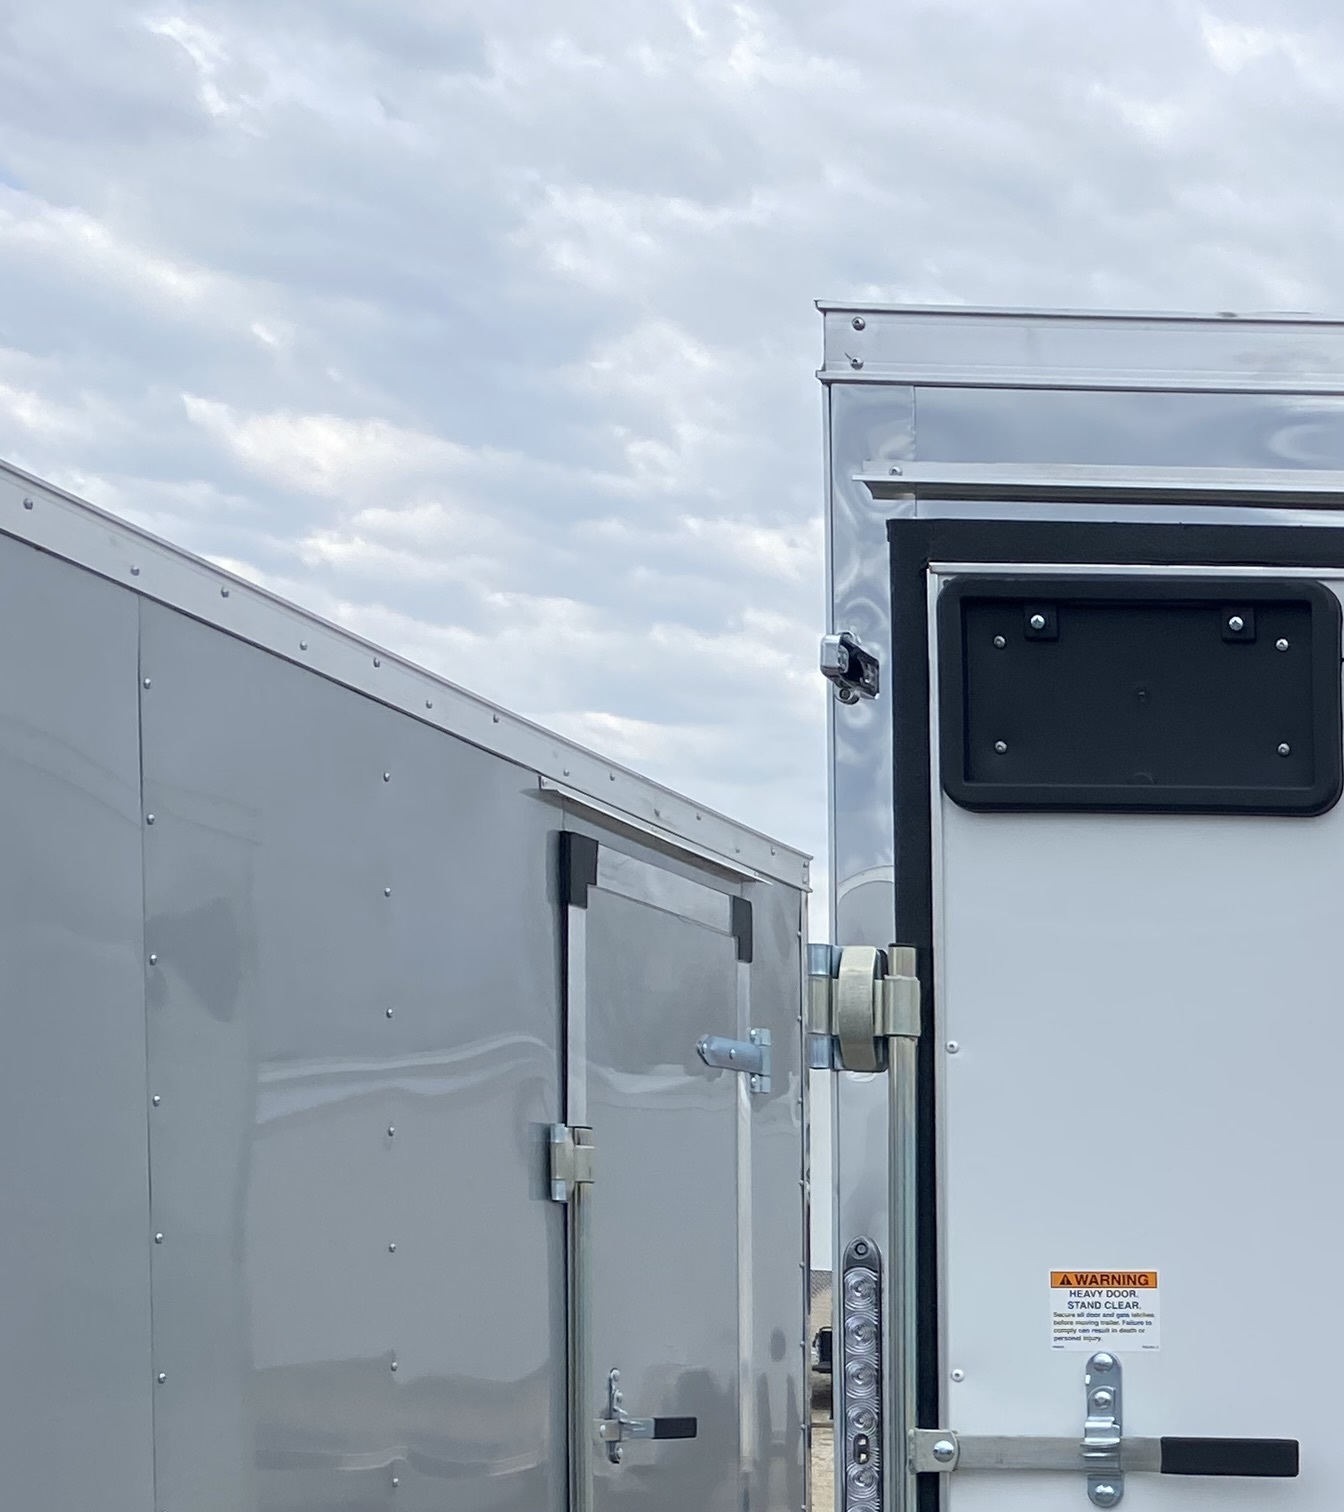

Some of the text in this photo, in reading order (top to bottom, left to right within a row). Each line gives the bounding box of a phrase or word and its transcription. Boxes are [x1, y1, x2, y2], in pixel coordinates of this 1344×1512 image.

[1074, 1274, 1149, 1286] WARNING
[1069, 1290, 1139, 1298] HEAVY DOOR.
[1067, 1301, 1141, 1309] STAND CLEAR.
